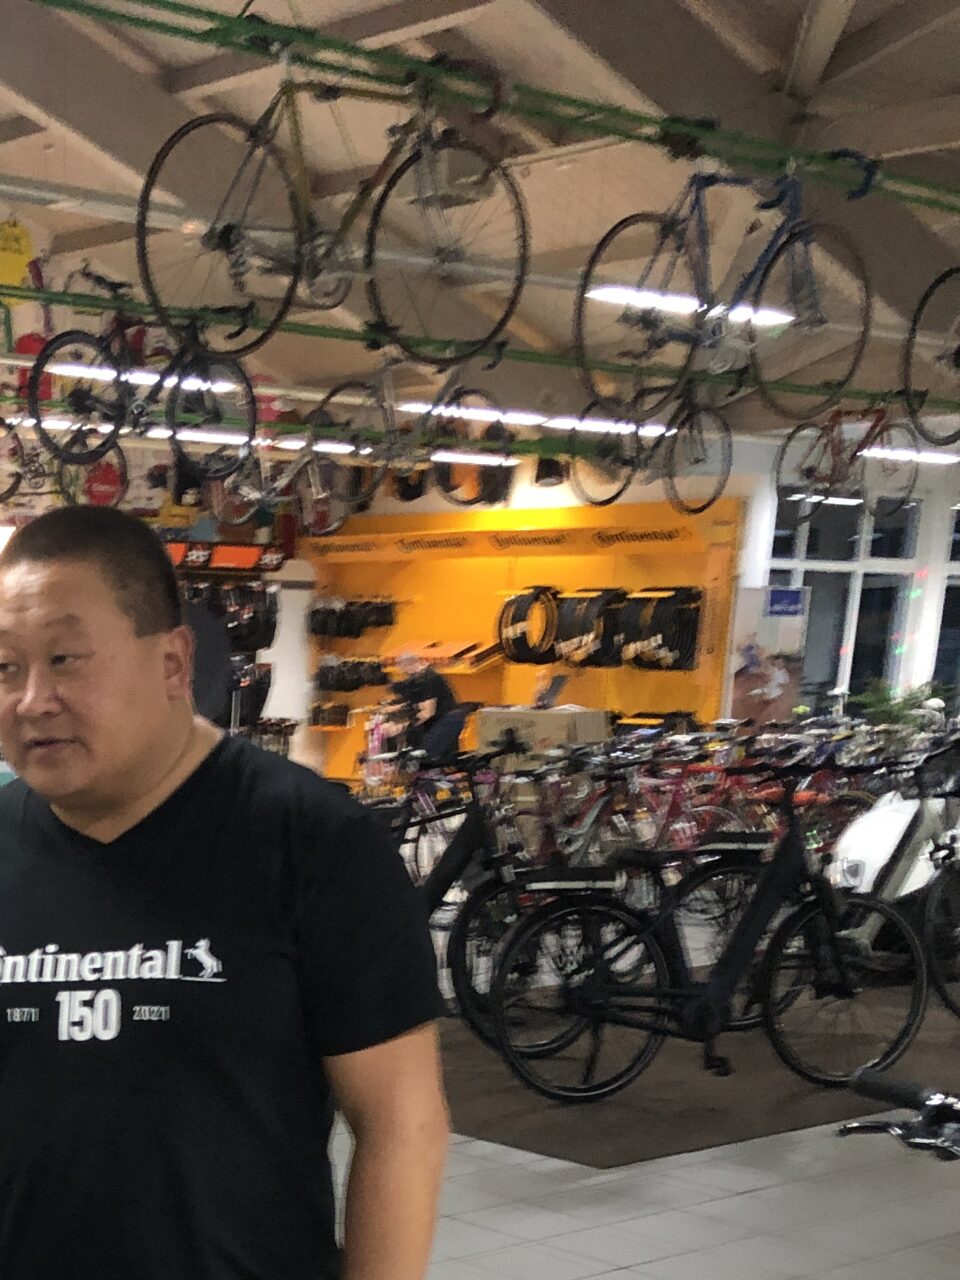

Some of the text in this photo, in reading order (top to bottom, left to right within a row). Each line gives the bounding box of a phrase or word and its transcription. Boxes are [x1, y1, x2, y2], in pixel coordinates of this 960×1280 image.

[6, 988, 170, 1042] 1871 150 2021
